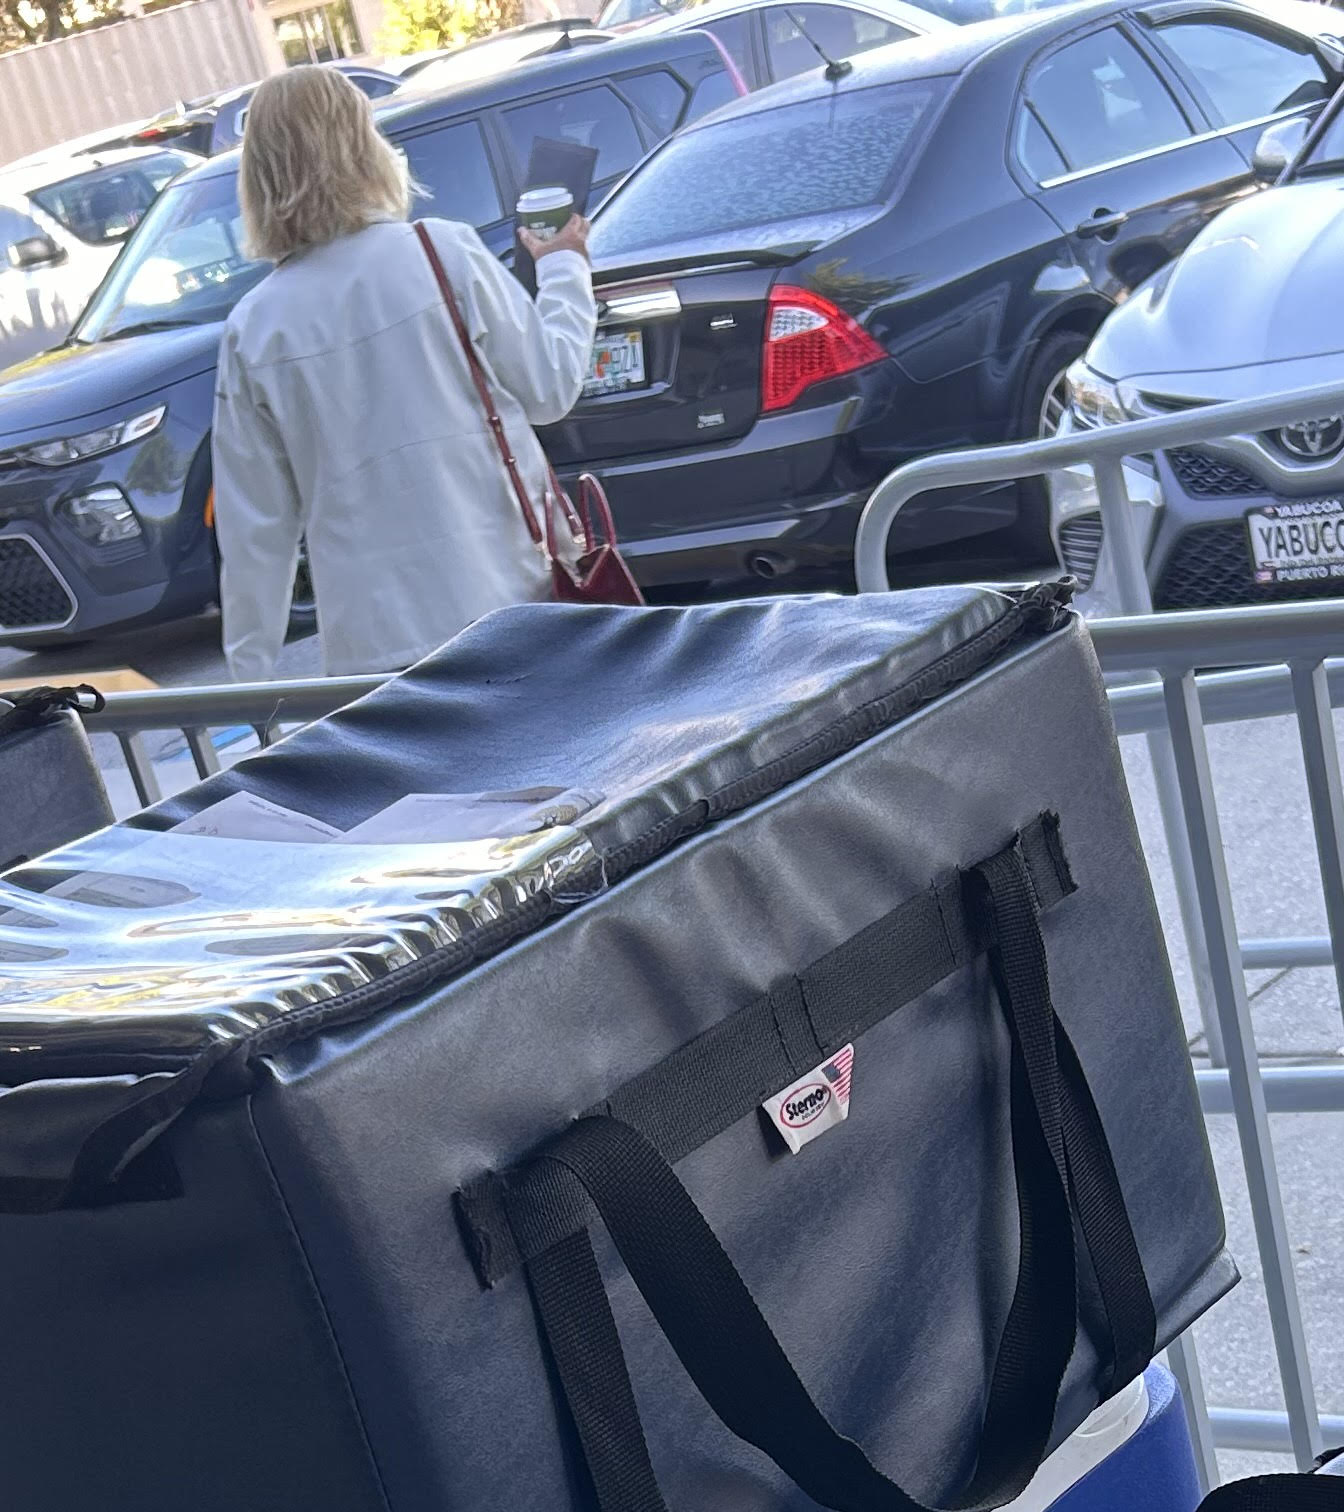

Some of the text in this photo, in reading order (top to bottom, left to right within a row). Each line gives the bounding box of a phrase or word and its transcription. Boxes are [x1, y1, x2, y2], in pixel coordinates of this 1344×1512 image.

[1275, 500, 1343, 518] YABUCOA
[1276, 566, 1329, 581] PUERTO
[786, 1087, 824, 1121] Sterno
